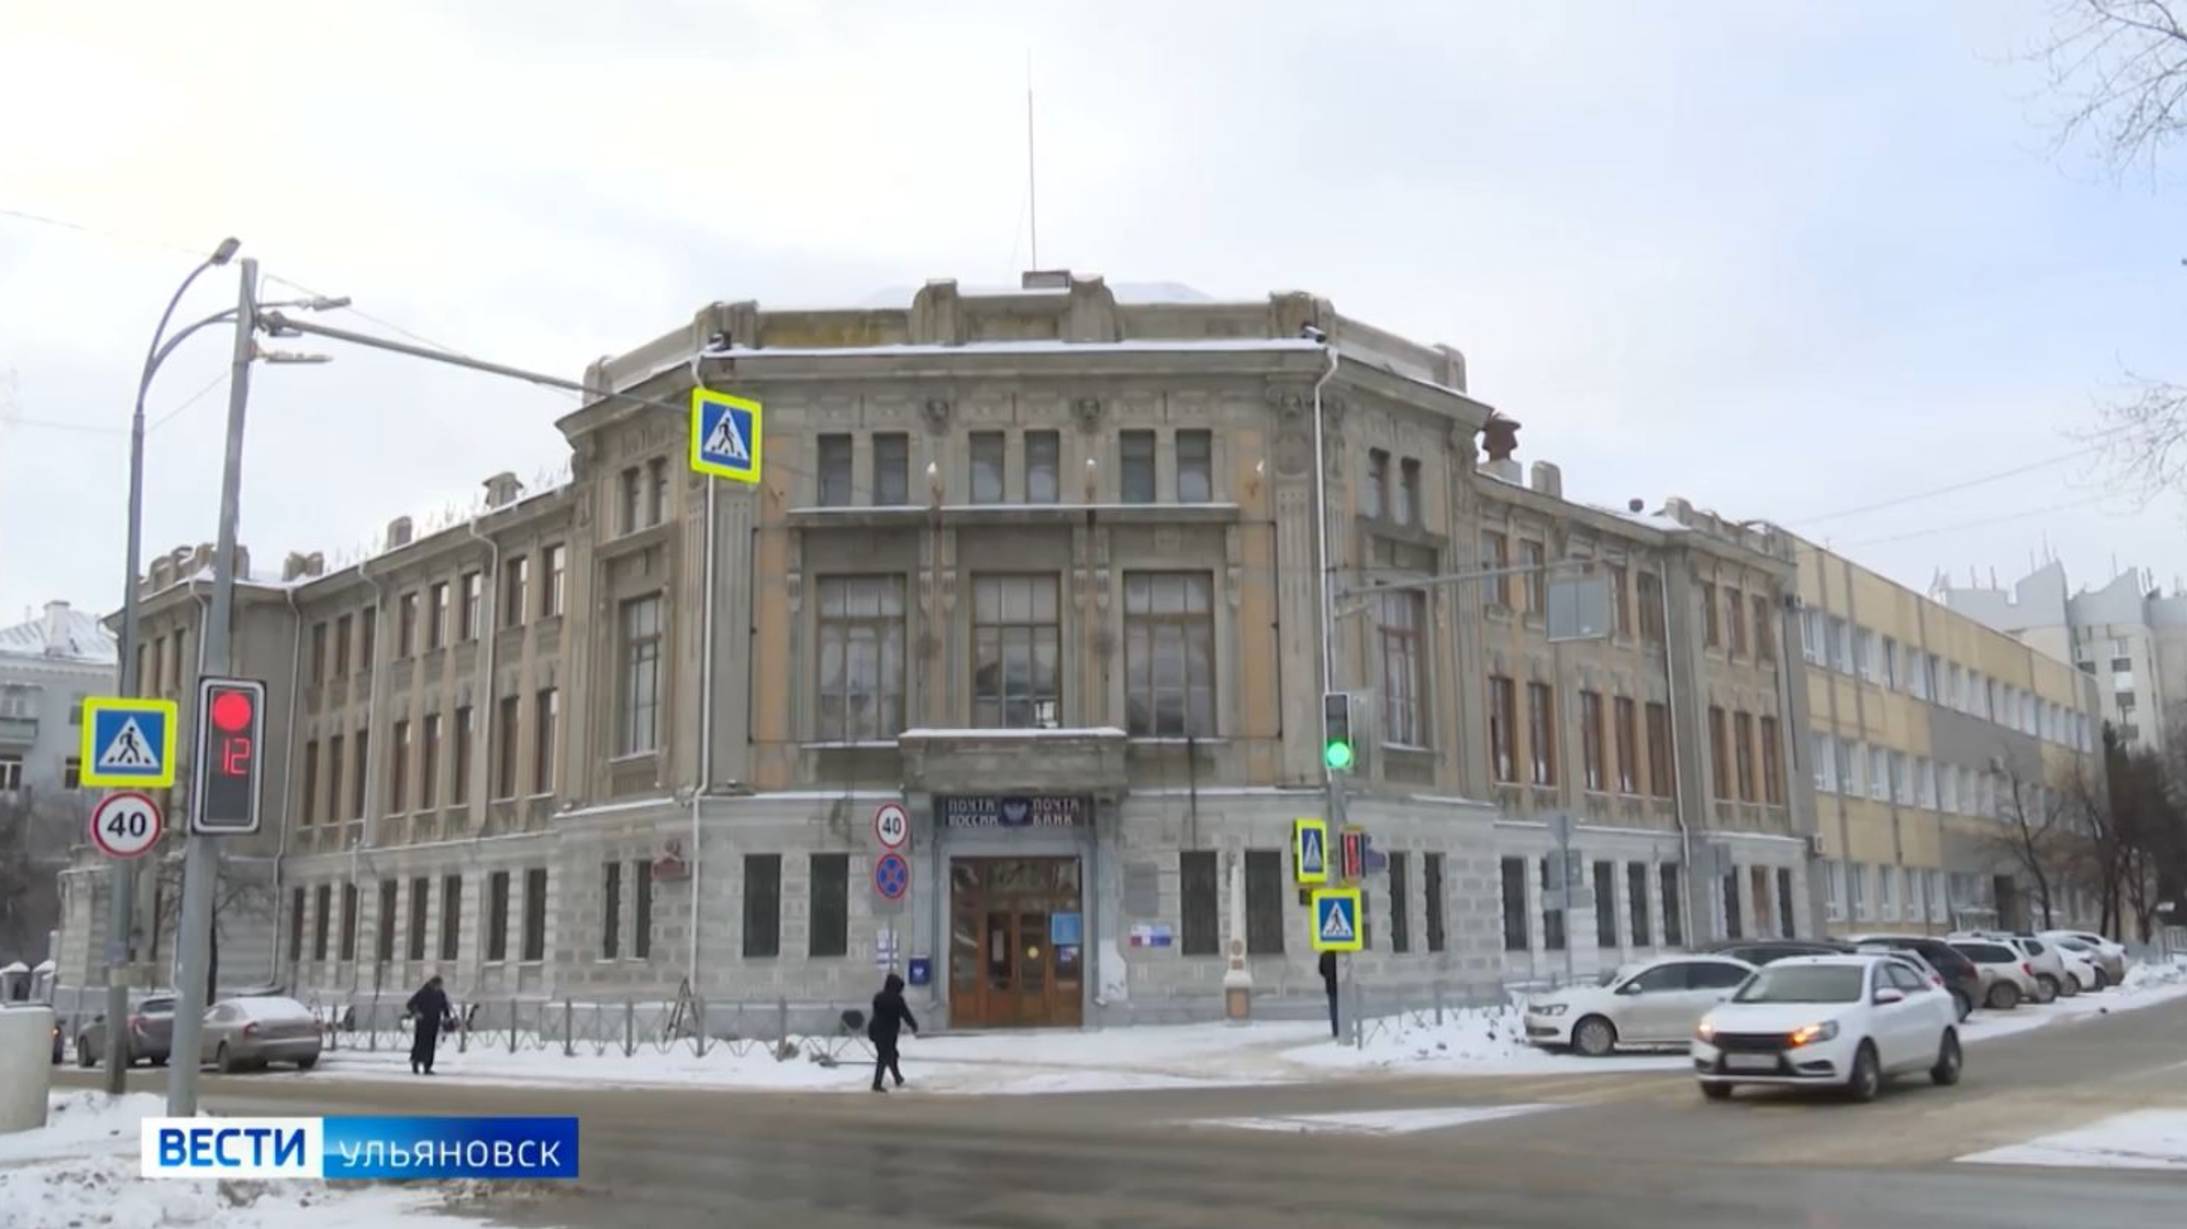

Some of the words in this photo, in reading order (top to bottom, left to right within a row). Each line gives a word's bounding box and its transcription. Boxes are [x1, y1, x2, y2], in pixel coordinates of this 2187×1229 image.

[224, 737, 251, 775] 12
[948, 799, 996, 812] ПОЧТА
[1033, 799, 1080, 813] ПОЧТА
[107, 811, 147, 837] 40
[882, 817, 901, 835] 40
